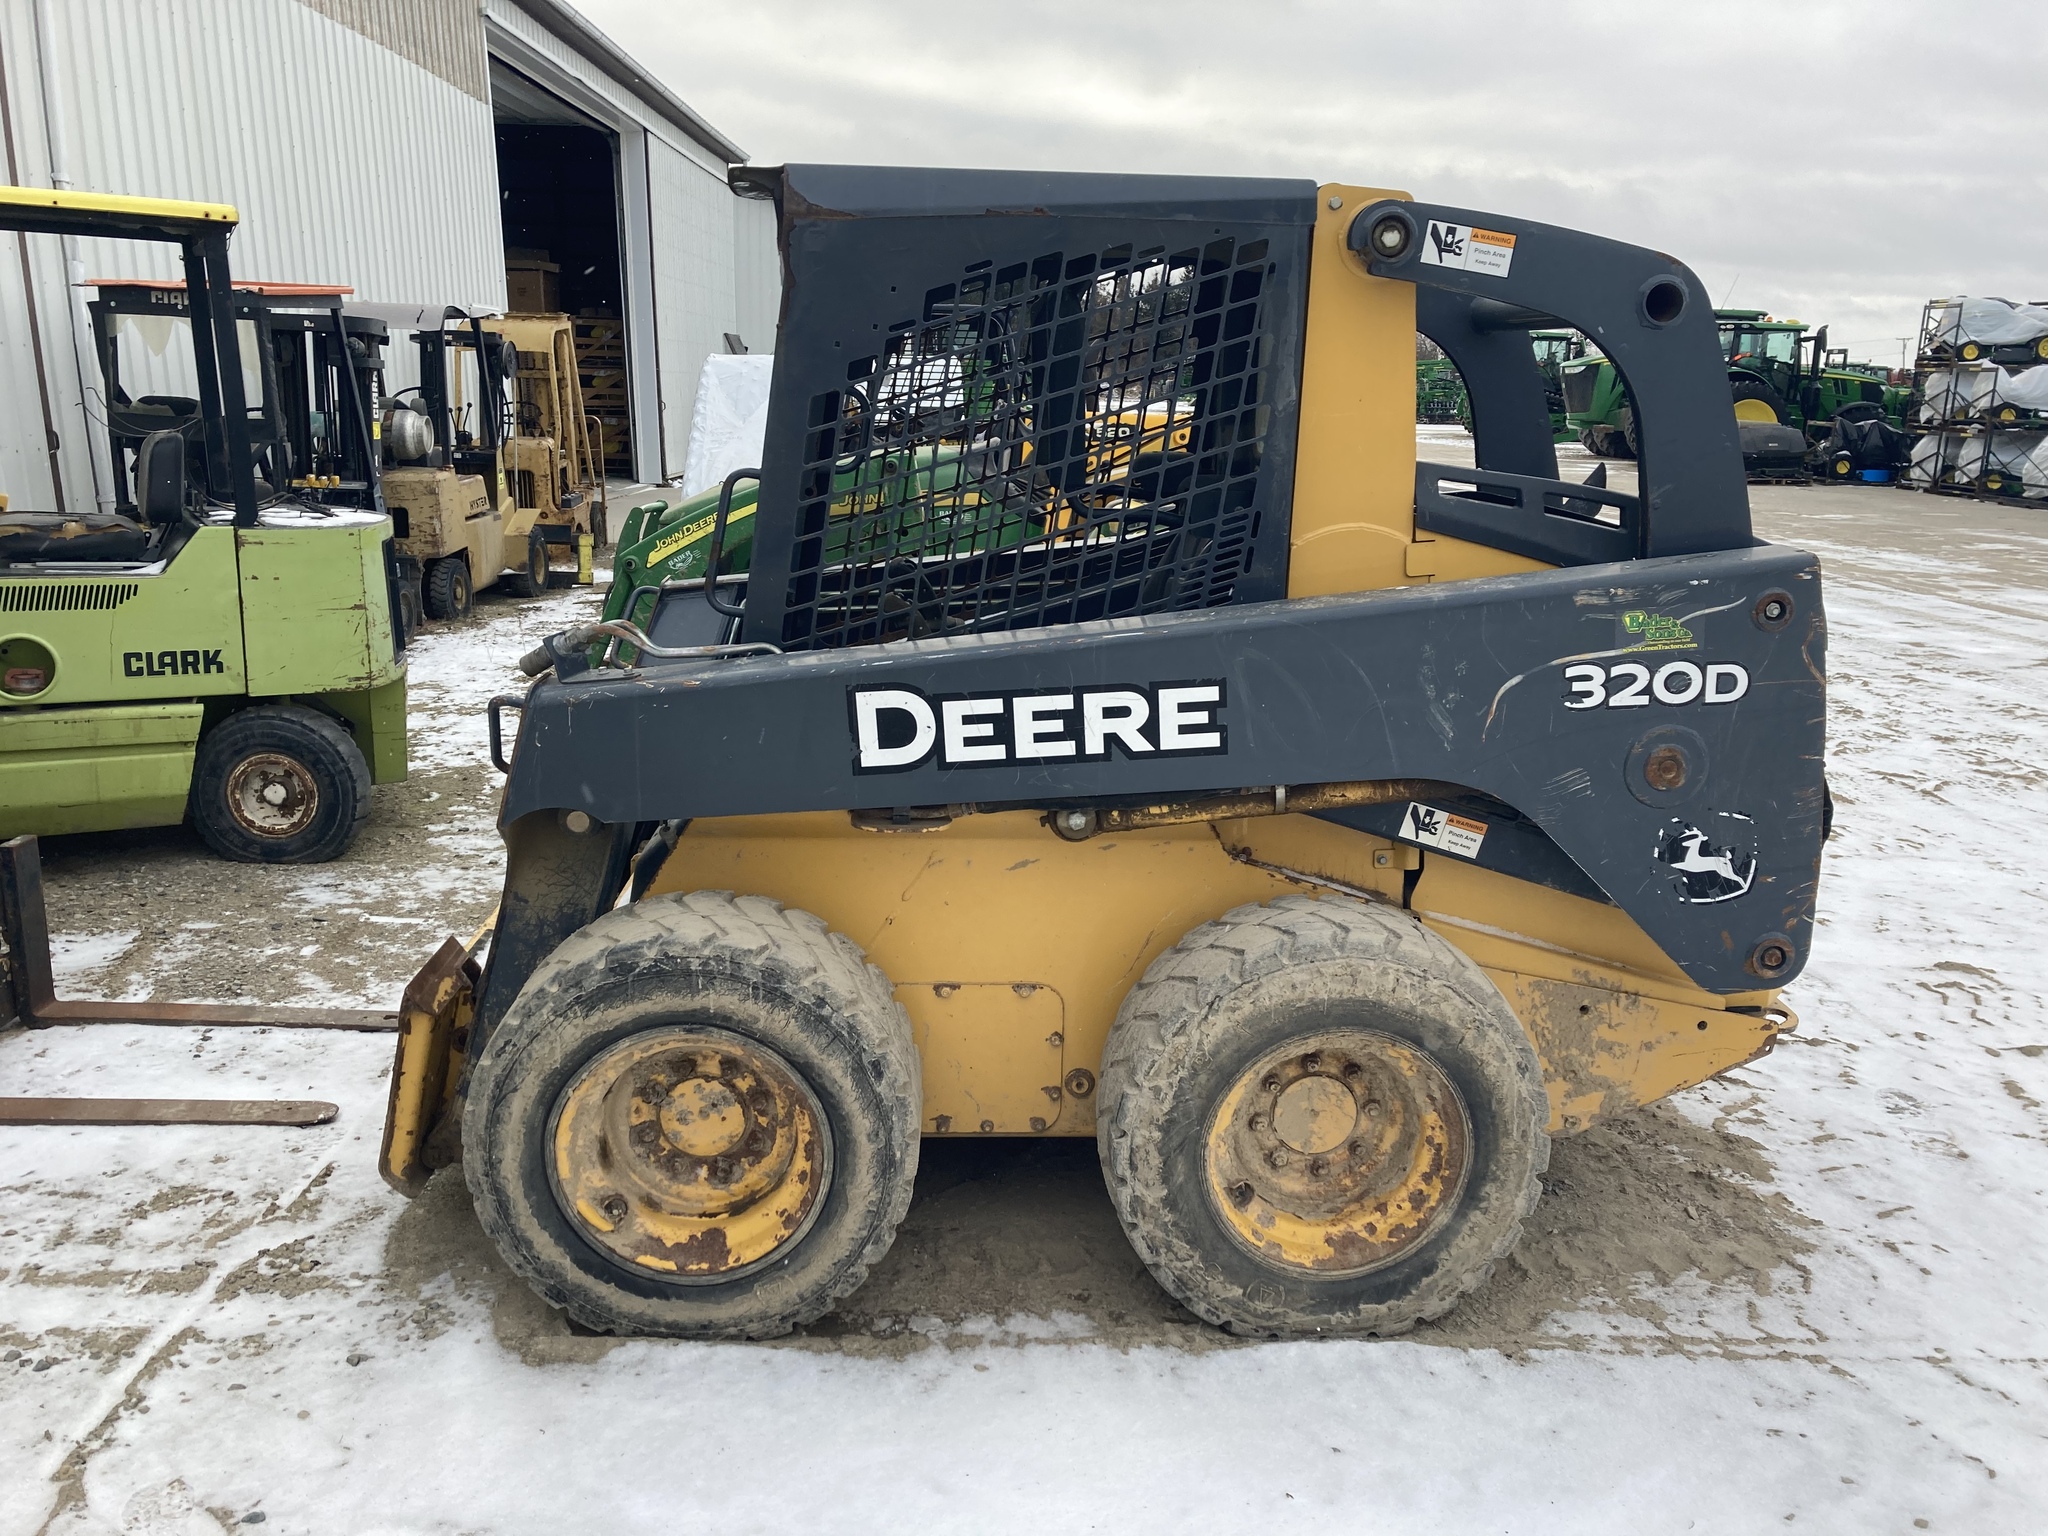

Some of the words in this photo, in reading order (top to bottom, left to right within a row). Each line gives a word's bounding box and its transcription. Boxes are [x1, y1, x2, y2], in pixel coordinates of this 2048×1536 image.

[1480, 232, 1512, 244] WARNING
[1474, 247, 1491, 256] Pinch
[1493, 250, 1507, 259] Area
[469, 496, 487, 510] HYSTER
[654, 530, 684, 552] JOHN
[1646, 628, 1677, 639] Sons
[1622, 642, 1699, 653] www.GreenTractors.com
[123, 649, 224, 677] CLARK
[1563, 661, 1750, 709] 320D
[855, 685, 1222, 768] DEERE
[1455, 819, 1484, 832] WARNING
[1448, 829, 1464, 839] Pinch
[1464, 834, 1477, 843] Area
[1447, 839, 1460, 847] Keep
[1459, 843, 1472, 851] Away
